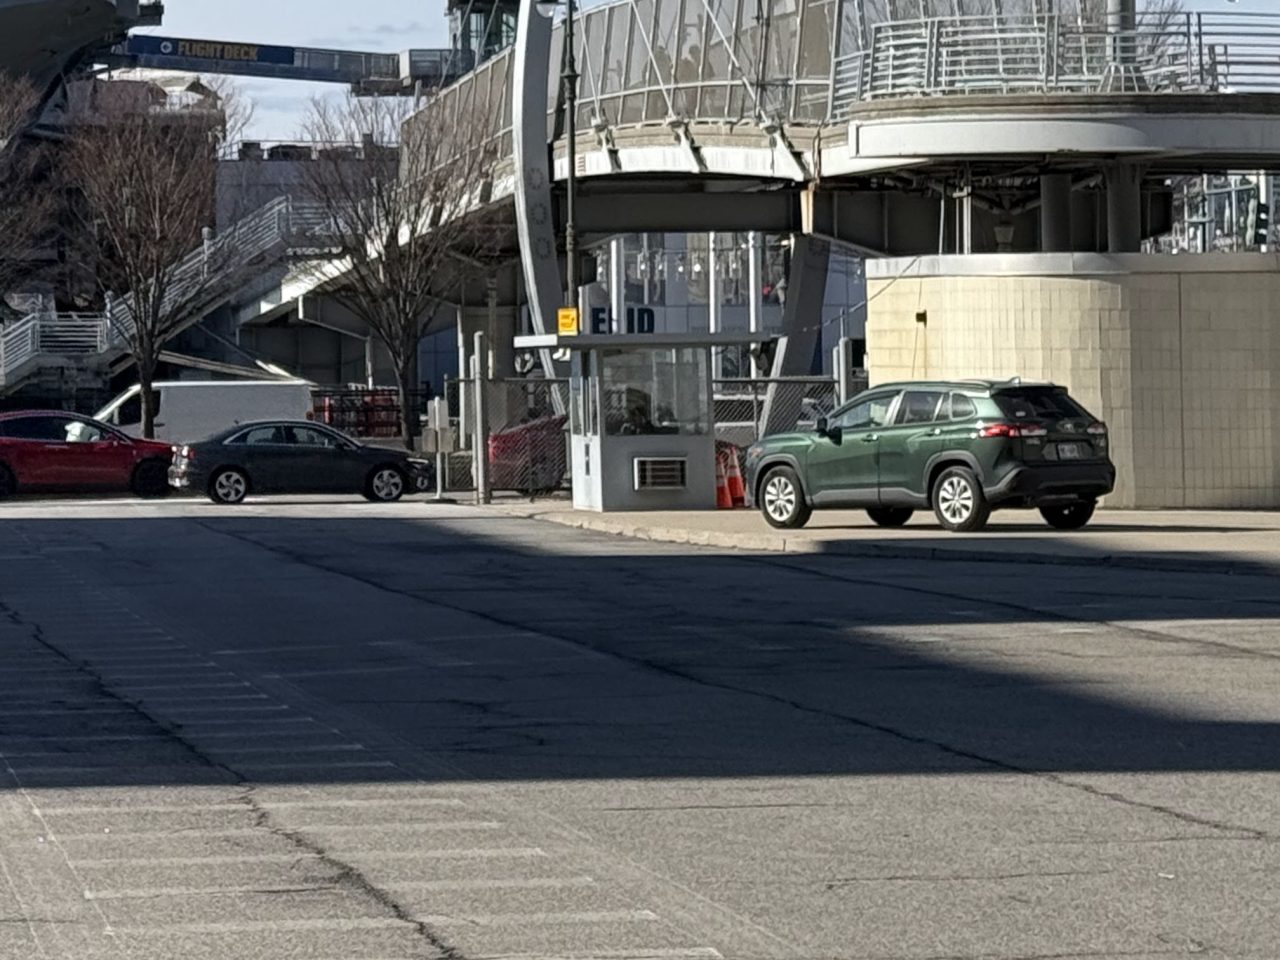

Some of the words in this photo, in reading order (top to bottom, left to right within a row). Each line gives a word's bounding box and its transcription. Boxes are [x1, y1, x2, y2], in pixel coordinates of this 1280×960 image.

[178, 41, 223, 58] FLIGHT
[224, 45, 258, 60] DECK
[591, 307, 655, 334] EID
